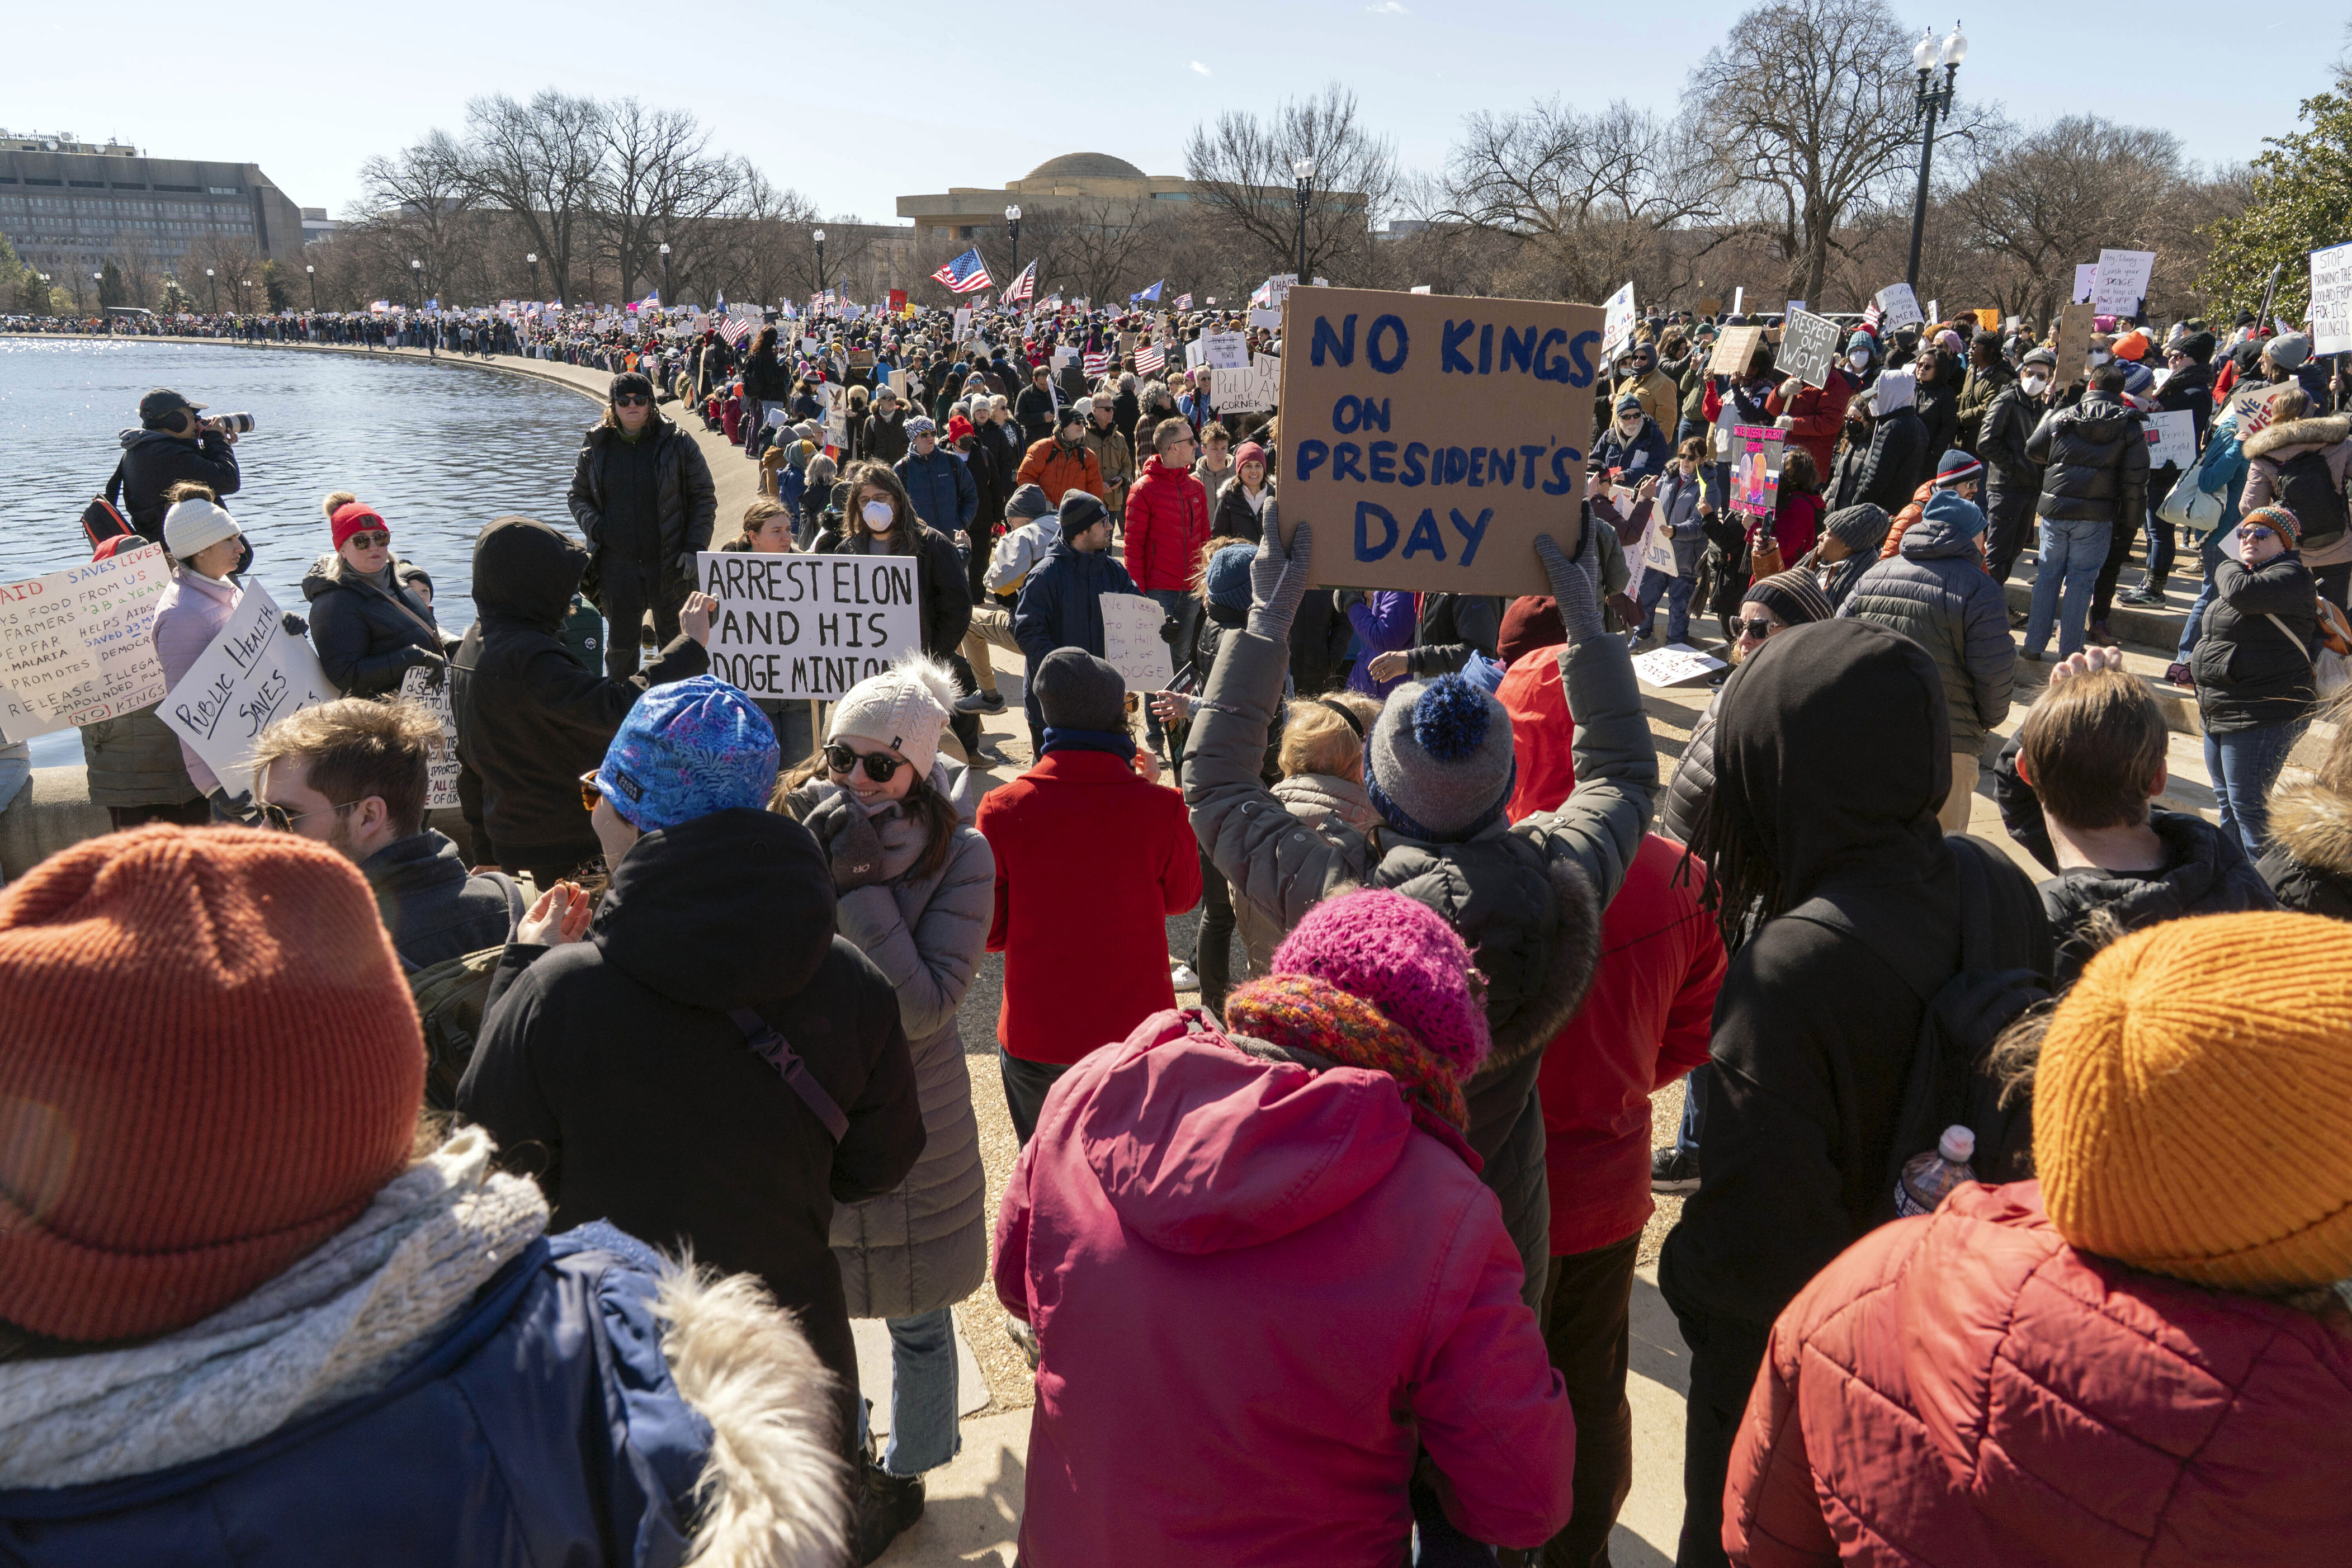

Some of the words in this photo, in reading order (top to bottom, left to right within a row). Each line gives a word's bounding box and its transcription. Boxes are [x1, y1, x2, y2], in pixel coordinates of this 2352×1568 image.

[2103, 267, 2121, 276] Leash
[2124, 269, 2141, 277] your
[2320, 248, 2344, 269] STOP
[2314, 271, 2339, 287] DRINKING
[2340, 266, 2352, 282] THE
[1882, 289, 1894, 300] AN
[2097, 296, 2113, 305] PAWS
[1790, 311, 1836, 342] RESPECT
[2316, 320, 2340, 339] KILLING
[1310, 313, 1410, 375] NO
[1441, 318, 1602, 389] KINGS
[1217, 370, 1239, 394] Put
[1332, 394, 1391, 434] ON
[2237, 398, 2261, 419] WE
[1296, 435, 1583, 496] PRESIDENT'S
[363, 516, 375, 527] M
[1354, 500, 1495, 568] DAY
[0, 582, 43, 604] AID
[68, 560, 116, 584] SAVES
[120, 544, 162, 567] LIVES
[707, 558, 823, 602] ARREST
[833, 562, 913, 606] ELON
[29, 598, 71, 618] FOOD
[79, 582, 120, 603] FROM
[124, 570, 146, 585] US
[1100, 597, 1122, 610] We
[1132, 597, 1156, 613] Need
[4, 612, 75, 642] FARMERS
[127, 581, 167, 599] YEAR
[1106, 618, 1122, 631] to
[1135, 618, 1155, 630] Get
[0, 636, 61, 659] EPFAR
[79, 616, 120, 638] HELPS
[84, 630, 122, 648] SAVED
[125, 622, 140, 634] 23
[721, 610, 800, 645] AND
[819, 612, 888, 648] HIS
[1109, 635, 1126, 645] the
[1135, 634, 1153, 646] Hell
[11, 659, 90, 689] PROMOTES
[101, 636, 153, 662] DEMOCR
[12, 649, 68, 672] MALARIA
[1111, 649, 1130, 659] out
[1140, 650, 1154, 659] of
[409, 667, 431, 679] THE
[712, 652, 785, 693] DOGE
[8, 681, 93, 717] RELEASE
[51, 681, 134, 716] IMPOUNDED
[75, 709, 105, 724] NO
[116, 684, 166, 714] KINGS
[176, 673, 234, 735] PUBLIC
[240, 669, 286, 738] SAVES
[433, 779, 447, 792] ALL
[433, 794, 446, 804] OF
